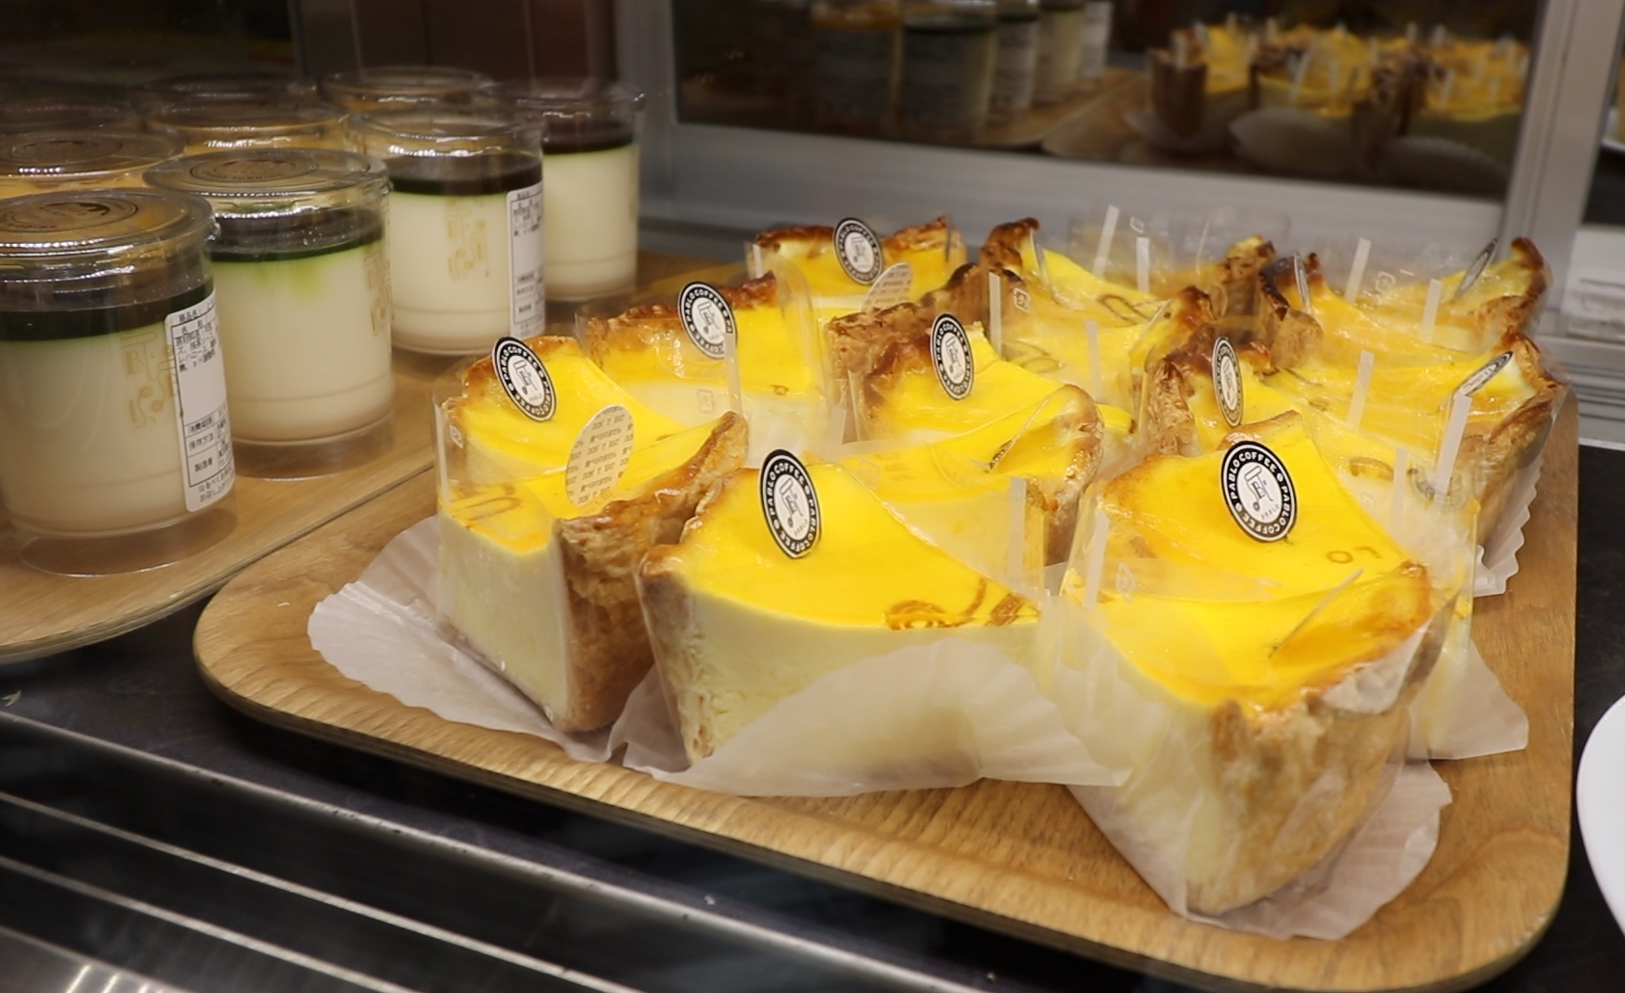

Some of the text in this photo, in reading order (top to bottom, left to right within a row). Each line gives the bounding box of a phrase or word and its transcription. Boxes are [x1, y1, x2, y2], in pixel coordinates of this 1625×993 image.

[766, 462, 807, 516] PABLO COFFEE
[1228, 451, 1278, 500] PABLO COFFEE
[1242, 485, 1291, 535] PABLO COFFEE
